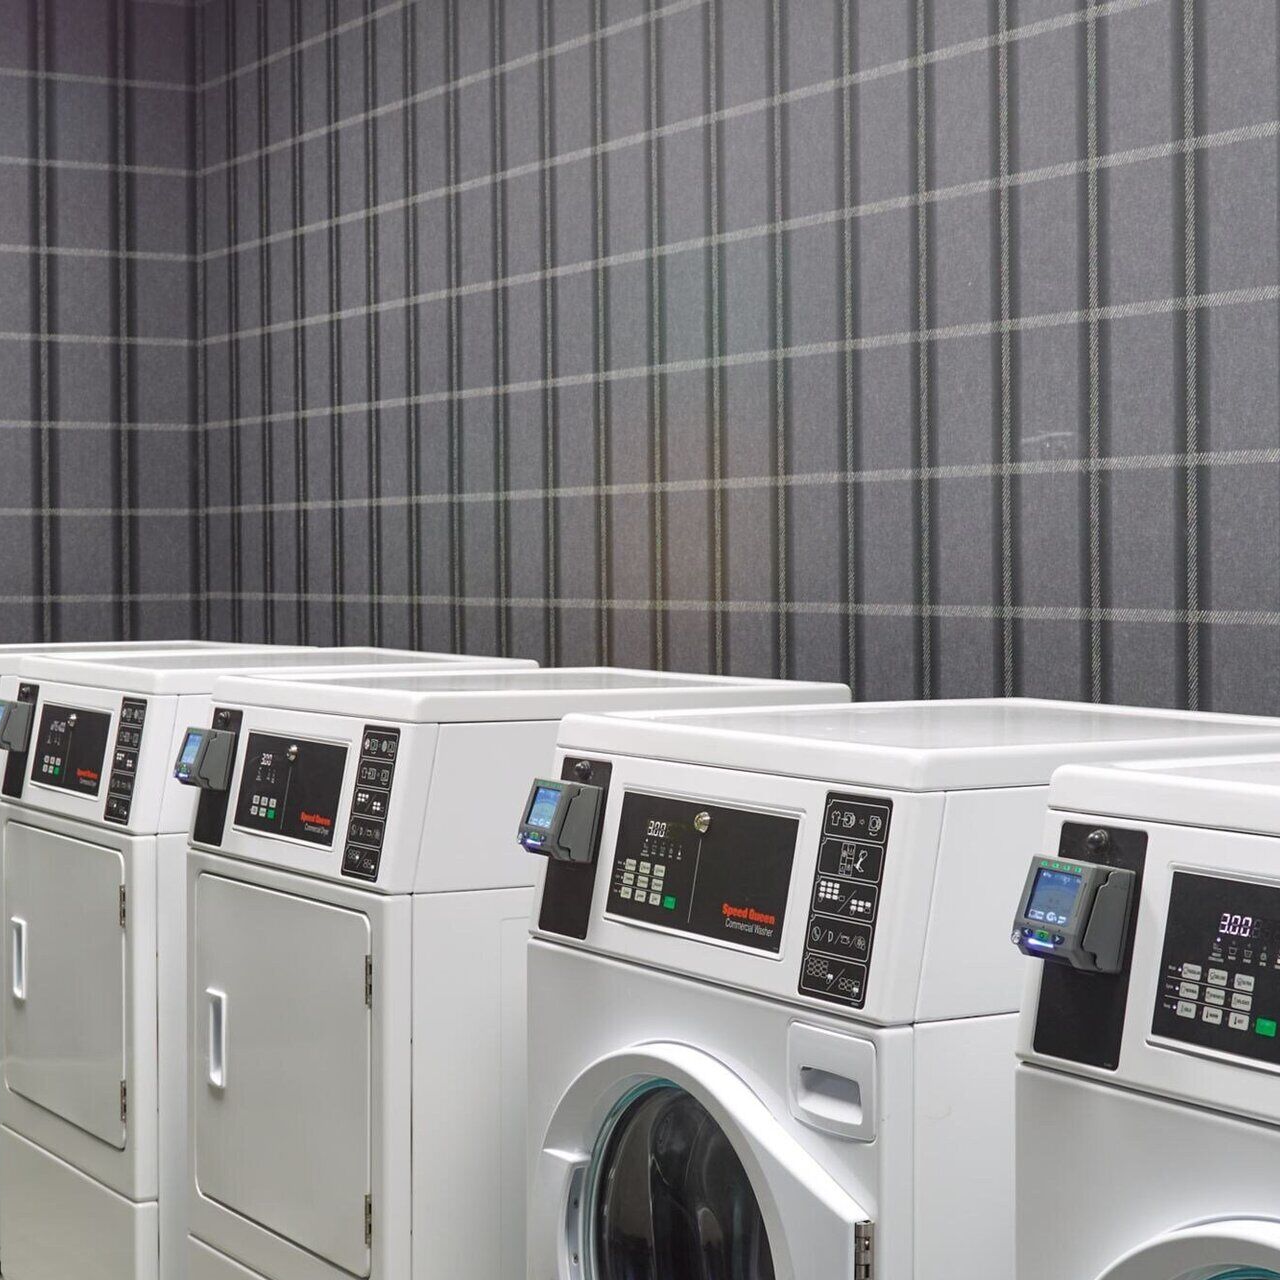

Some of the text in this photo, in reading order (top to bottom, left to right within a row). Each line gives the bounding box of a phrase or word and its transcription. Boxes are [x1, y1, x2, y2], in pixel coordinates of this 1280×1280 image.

[722, 903, 775, 925] Speed Queen
[1219, 913, 1253, 937] 3.00
